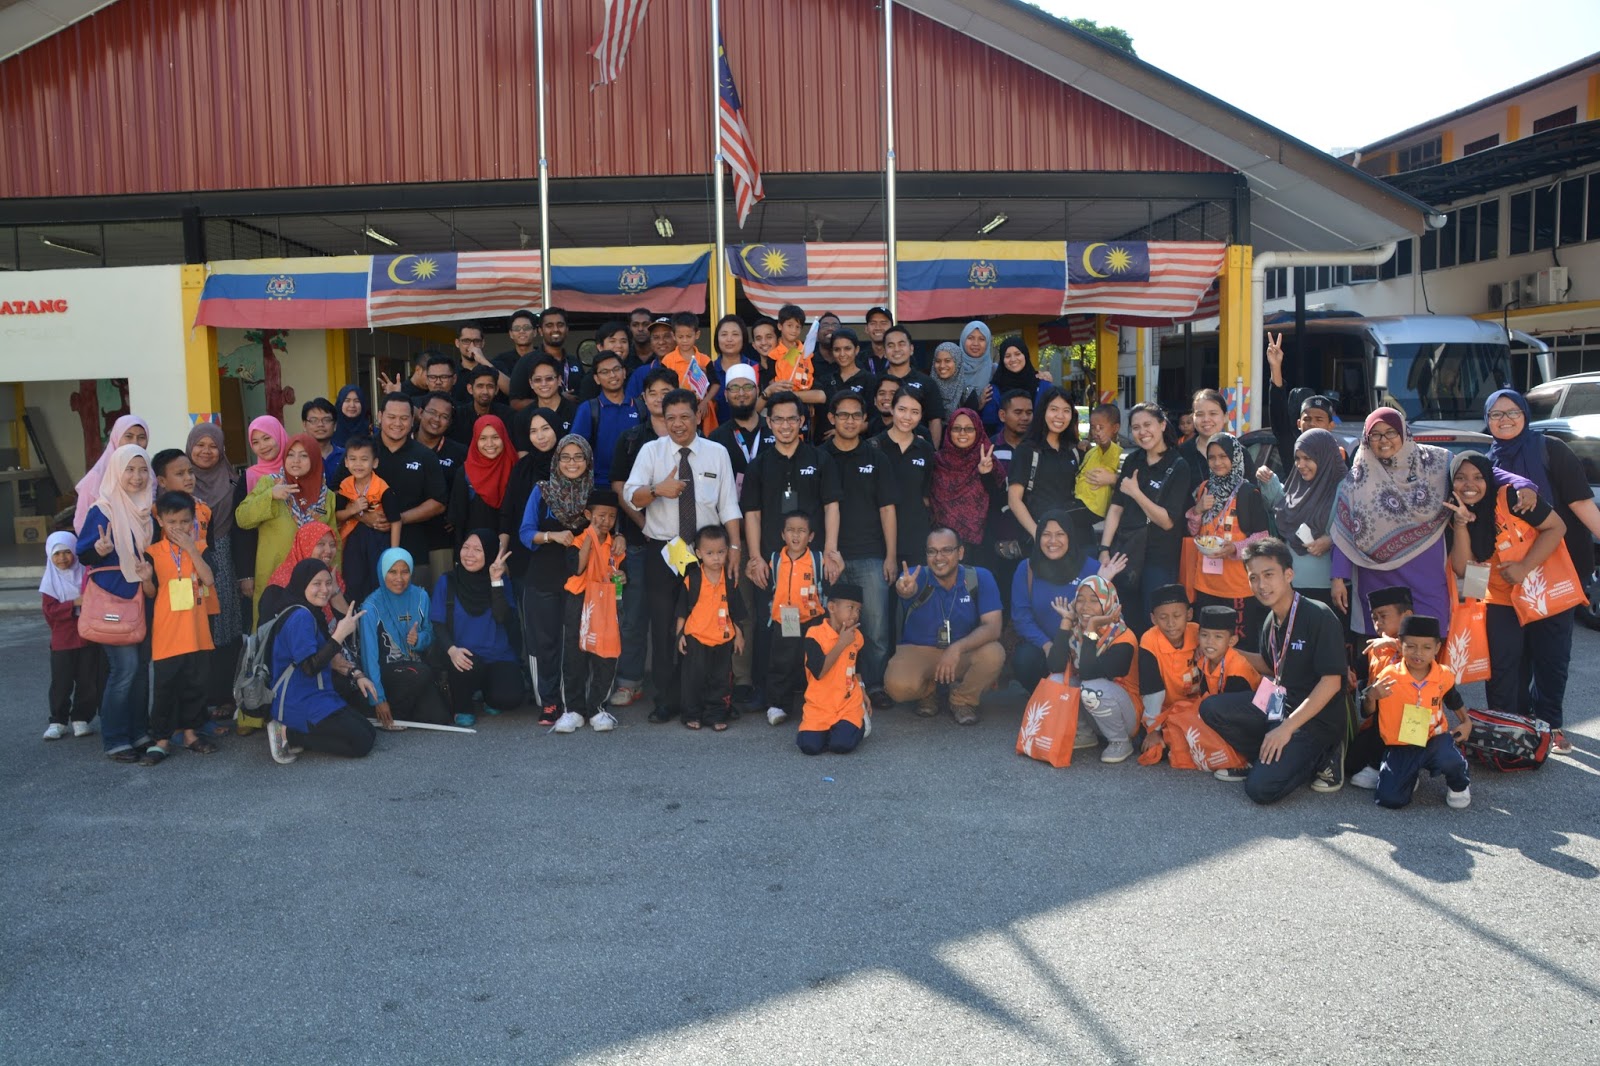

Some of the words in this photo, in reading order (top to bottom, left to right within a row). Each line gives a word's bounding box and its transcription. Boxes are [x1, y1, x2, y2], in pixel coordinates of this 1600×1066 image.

[0, 299, 68, 315] ATANG
[406, 461, 421, 471] TM
[439, 458, 453, 467] TM
[912, 458, 925, 467] TM
[800, 465, 816, 475] TM
[859, 464, 874, 473] TM
[960, 595, 970, 603] TM
[1291, 639, 1306, 651] TM
